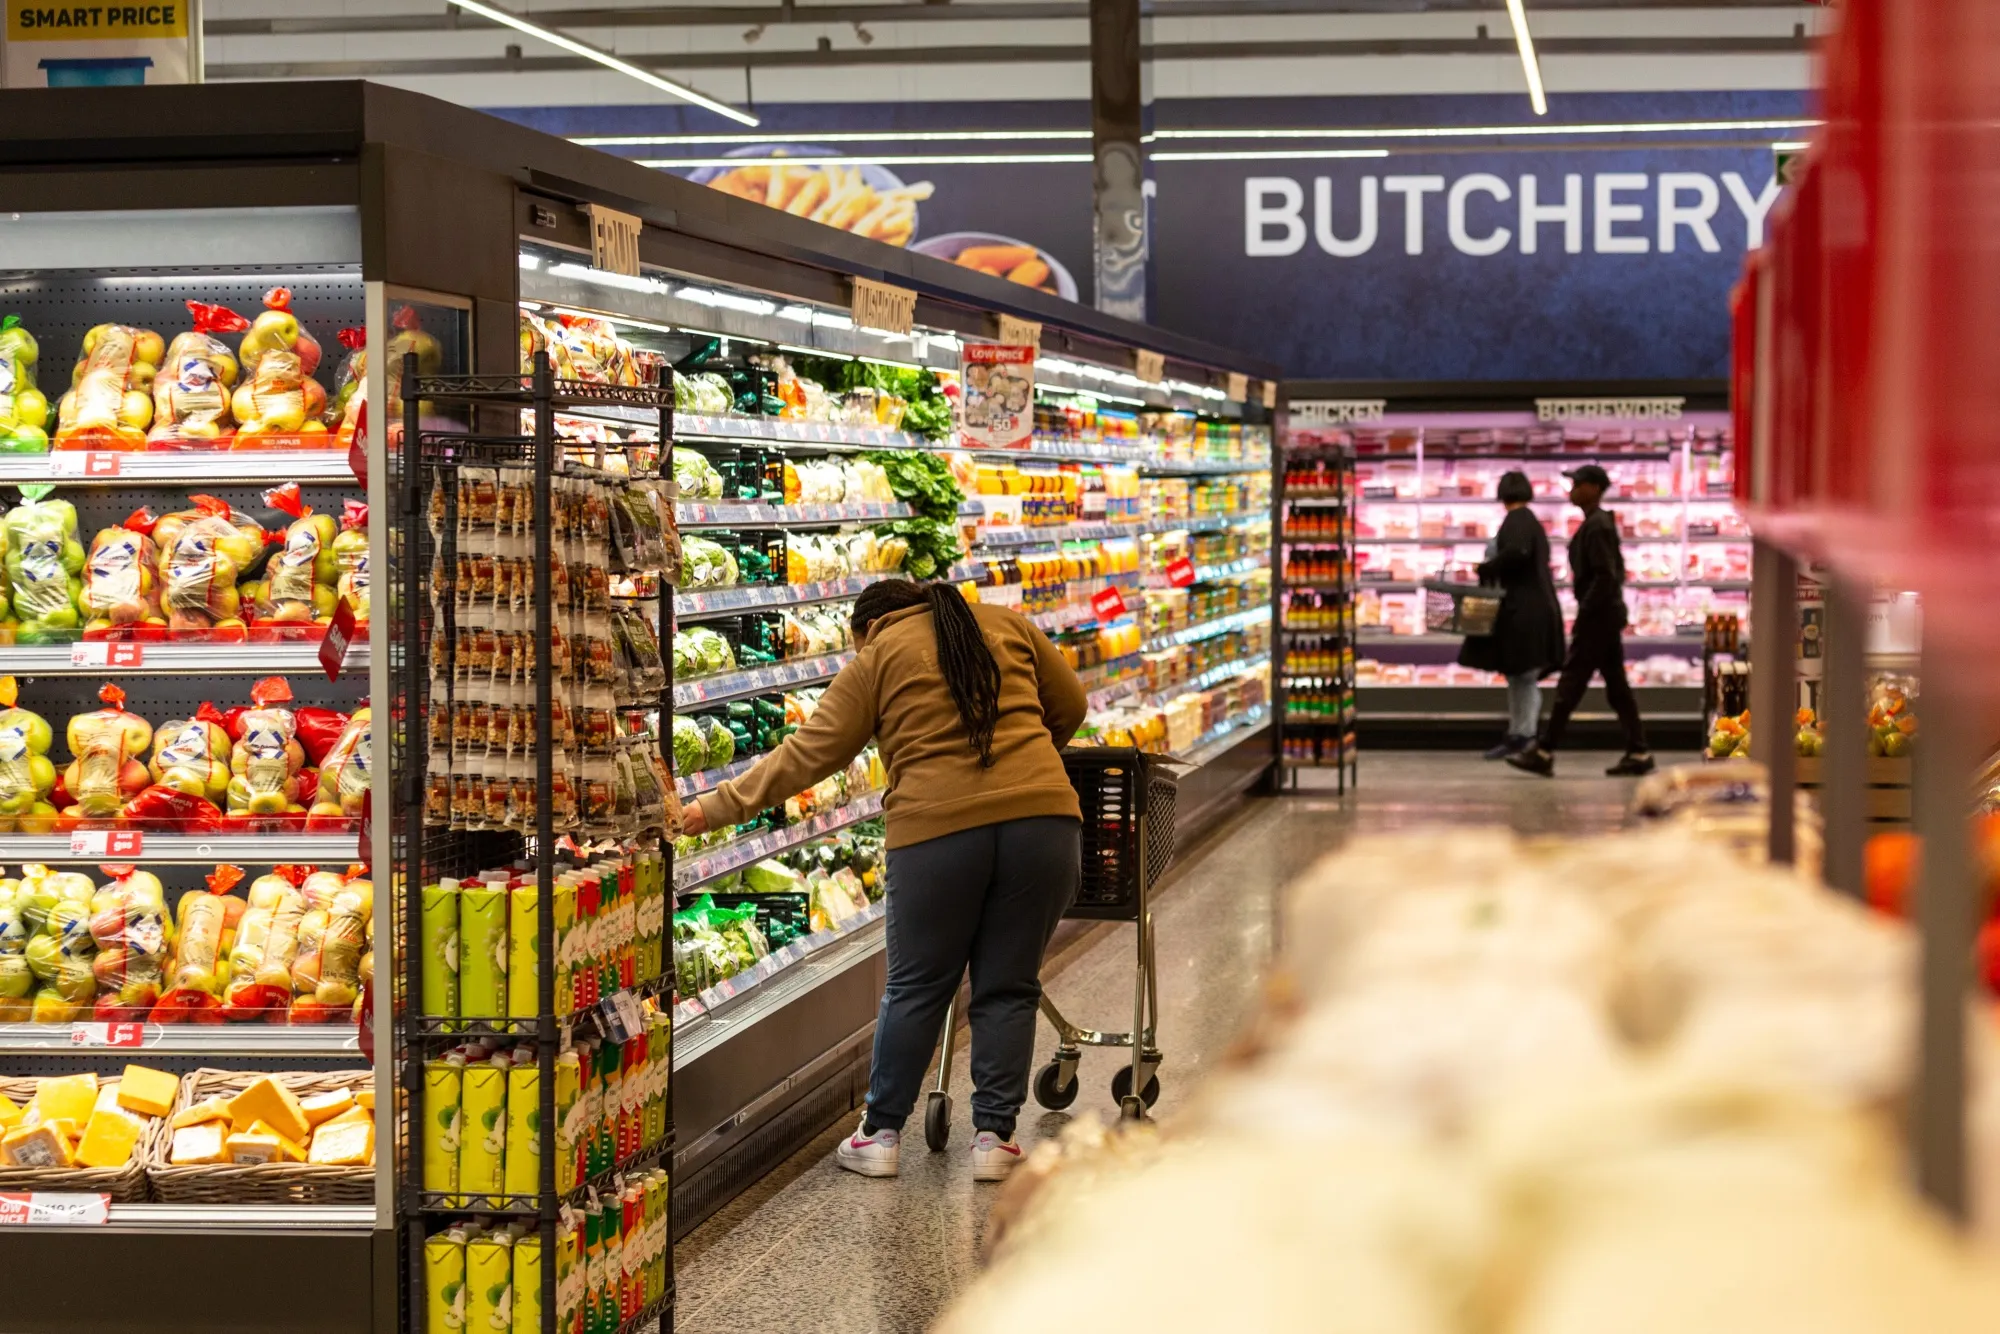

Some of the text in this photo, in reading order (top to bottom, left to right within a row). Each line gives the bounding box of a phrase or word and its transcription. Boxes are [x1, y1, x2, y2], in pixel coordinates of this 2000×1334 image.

[20, 6, 176, 27] SMART PRICE
[1245, 173, 1782, 257] BUTCHERY
[590, 208, 641, 276] FRUIT
[971, 348, 1024, 360] LOW PRICE
[1537, 398, 1684, 422] BOEREWORS
[0, 1202, 21, 1214] OW
